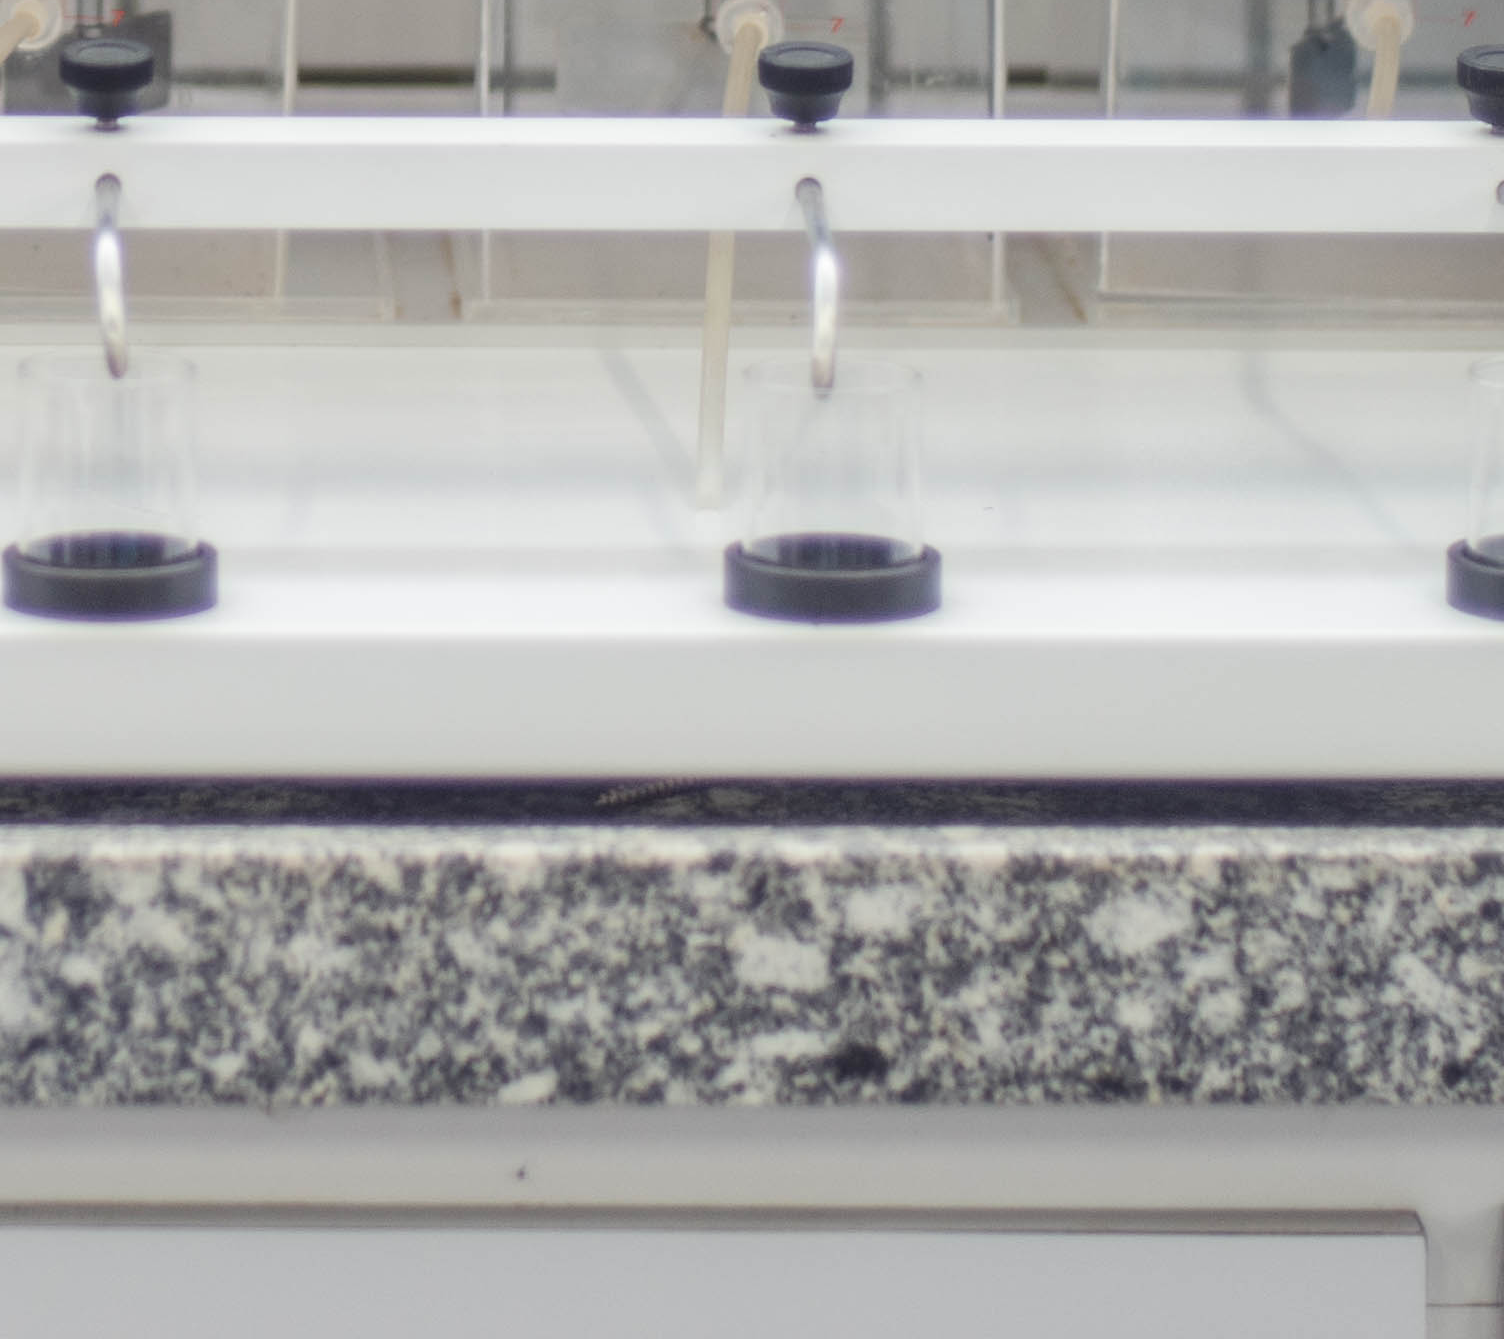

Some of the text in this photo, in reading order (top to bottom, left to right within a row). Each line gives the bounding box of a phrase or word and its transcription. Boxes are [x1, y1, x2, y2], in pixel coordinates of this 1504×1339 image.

[111, 10, 125, 27] 7
[830, 16, 845, 35] 7
[1462, 11, 1477, 28] 7
